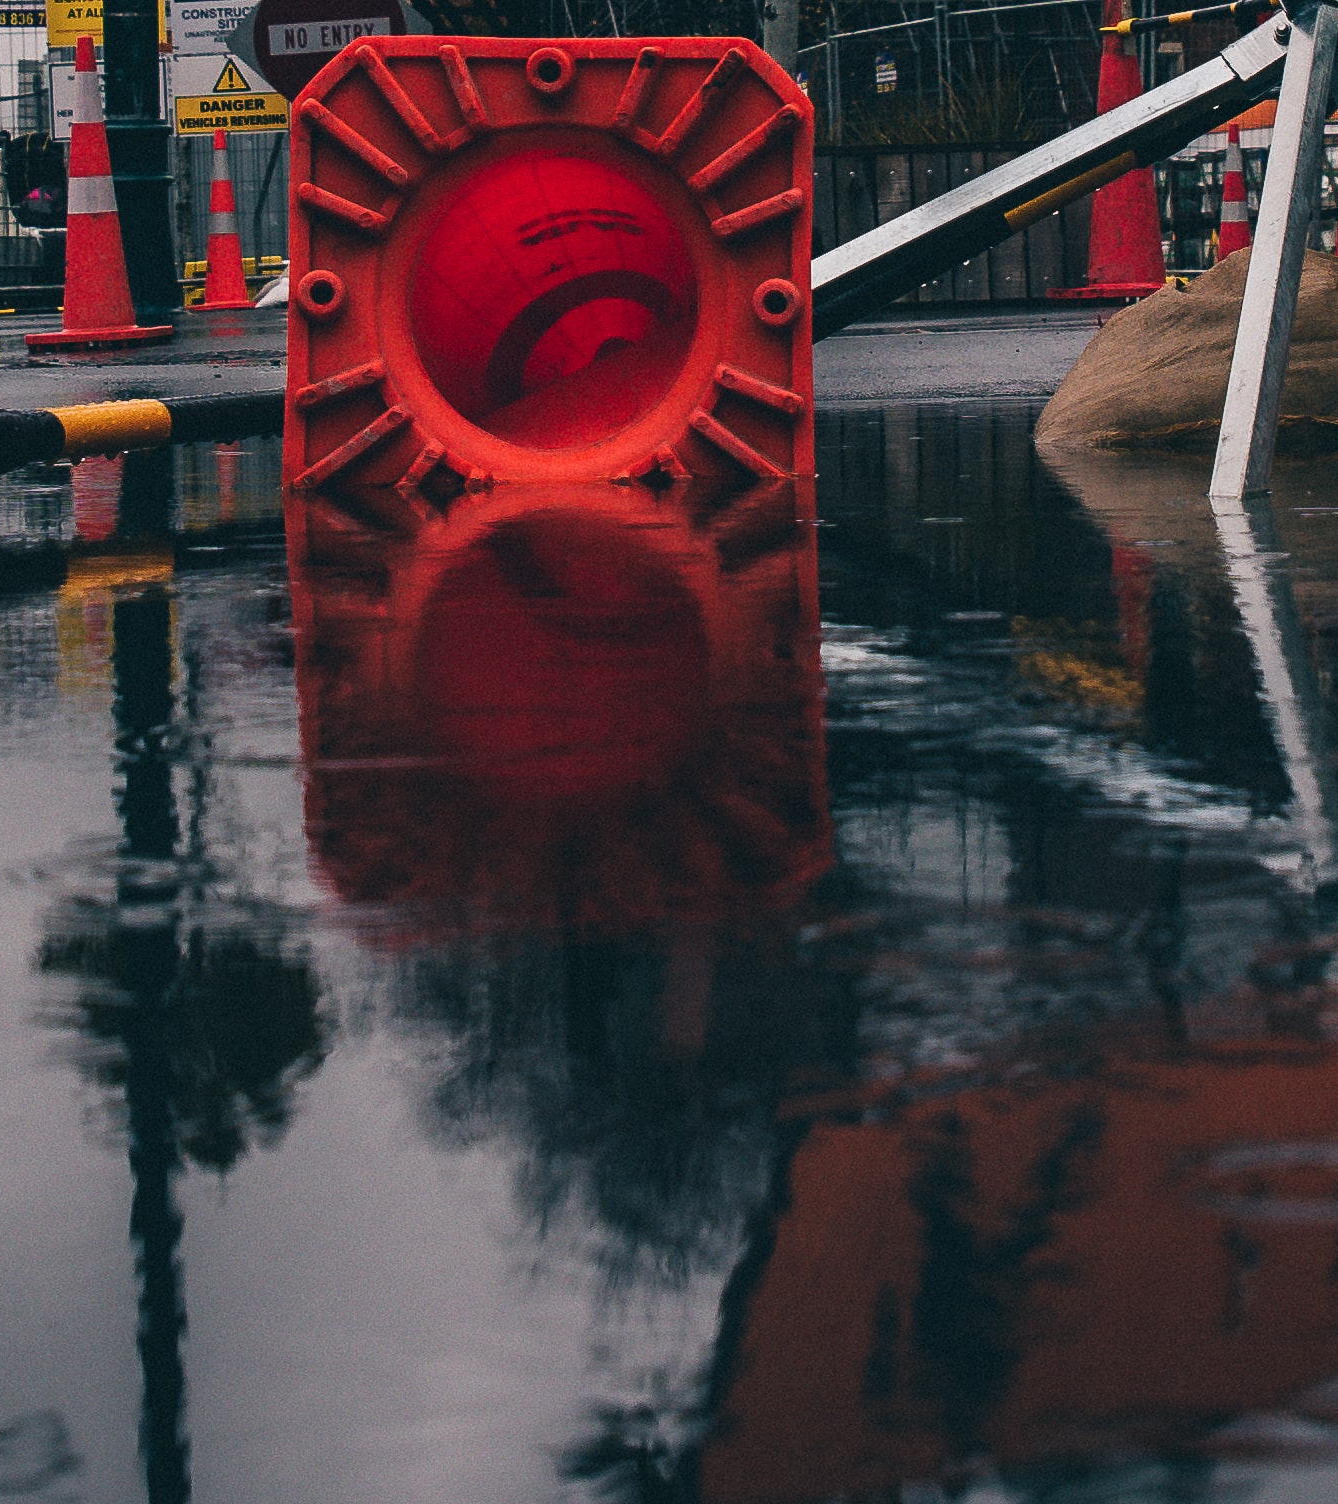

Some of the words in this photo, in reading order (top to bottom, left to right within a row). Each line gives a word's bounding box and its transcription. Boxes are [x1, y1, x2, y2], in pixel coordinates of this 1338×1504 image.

[67, 8, 83, 19] AT
[284, 27, 308, 49] NO
[320, 23, 375, 47] ENTRY
[200, 98, 265, 113] DANGER
[179, 116, 228, 129] VEHICLES
[230, 113, 287, 127] REVERSING
